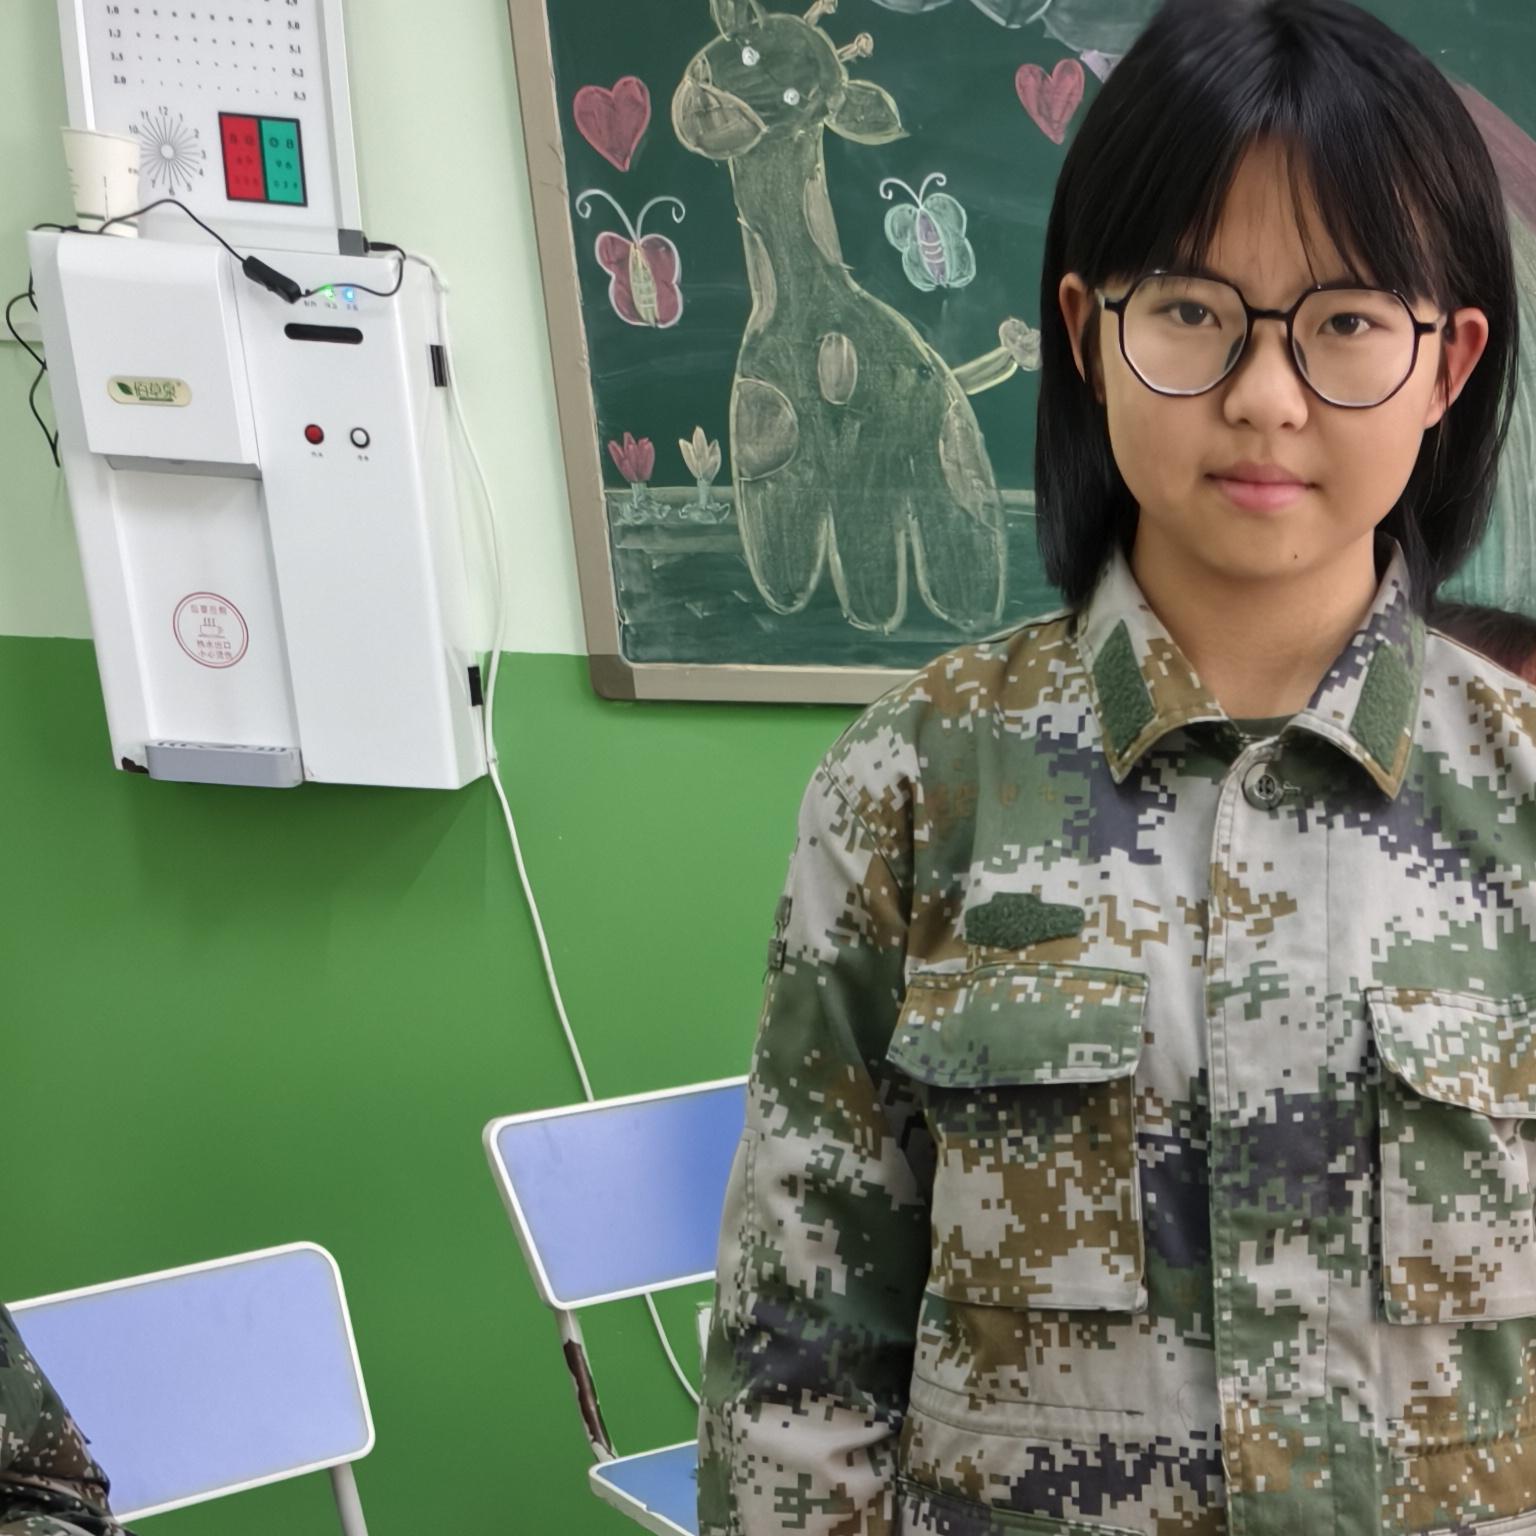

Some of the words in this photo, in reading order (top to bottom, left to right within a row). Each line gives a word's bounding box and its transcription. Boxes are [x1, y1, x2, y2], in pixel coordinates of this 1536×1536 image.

[140, 110, 149, 120] 11
[158, 105, 168, 116] 12
[128, 124, 139, 134] 10
[194, 128, 200, 139] 2
